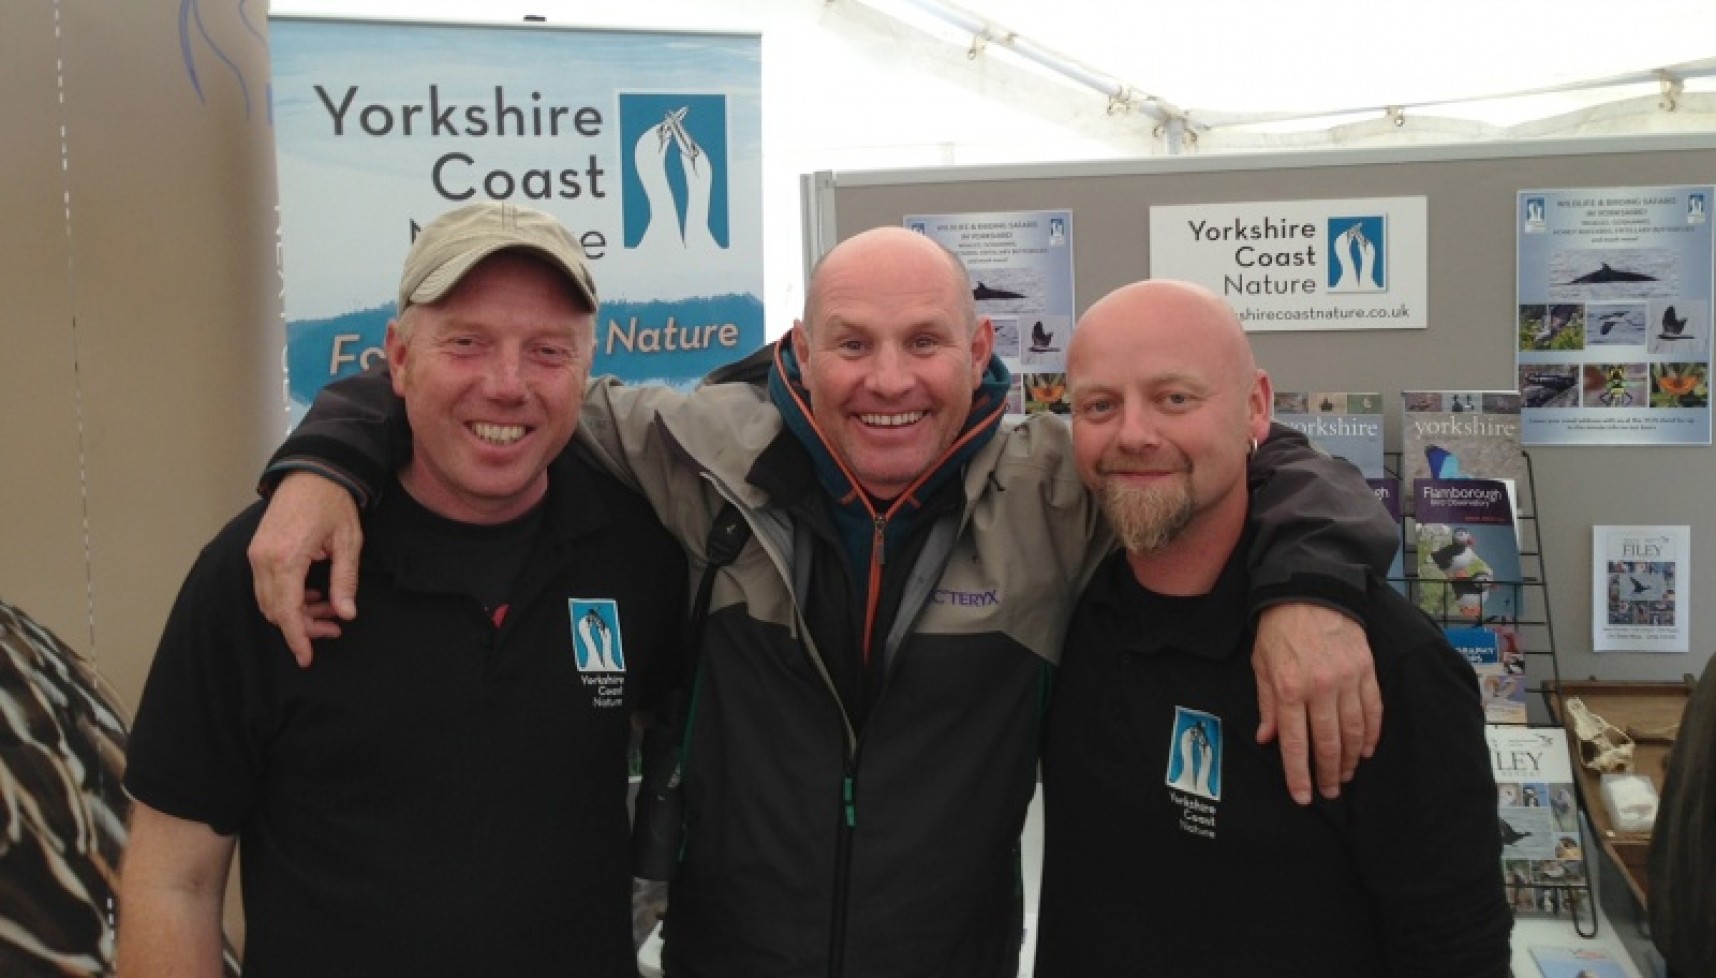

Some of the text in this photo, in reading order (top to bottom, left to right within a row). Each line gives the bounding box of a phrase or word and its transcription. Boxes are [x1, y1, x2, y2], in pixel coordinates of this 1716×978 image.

[313, 84, 603, 138] Yorkshire
[431, 151, 607, 202] Coast
[1187, 216, 1316, 241] Yorkshire
[1234, 245, 1316, 267] Coast
[1223, 273, 1316, 296] Nature
[1235, 303, 1411, 321] shirecoastnature.co.uk
[605, 317, 740, 356] Nature
[1415, 415, 1517, 440] yorkshire
[1423, 486, 1502, 503] Flamborough
[1623, 543, 1663, 556] FILEY
[1495, 751, 1544, 771] LEY
